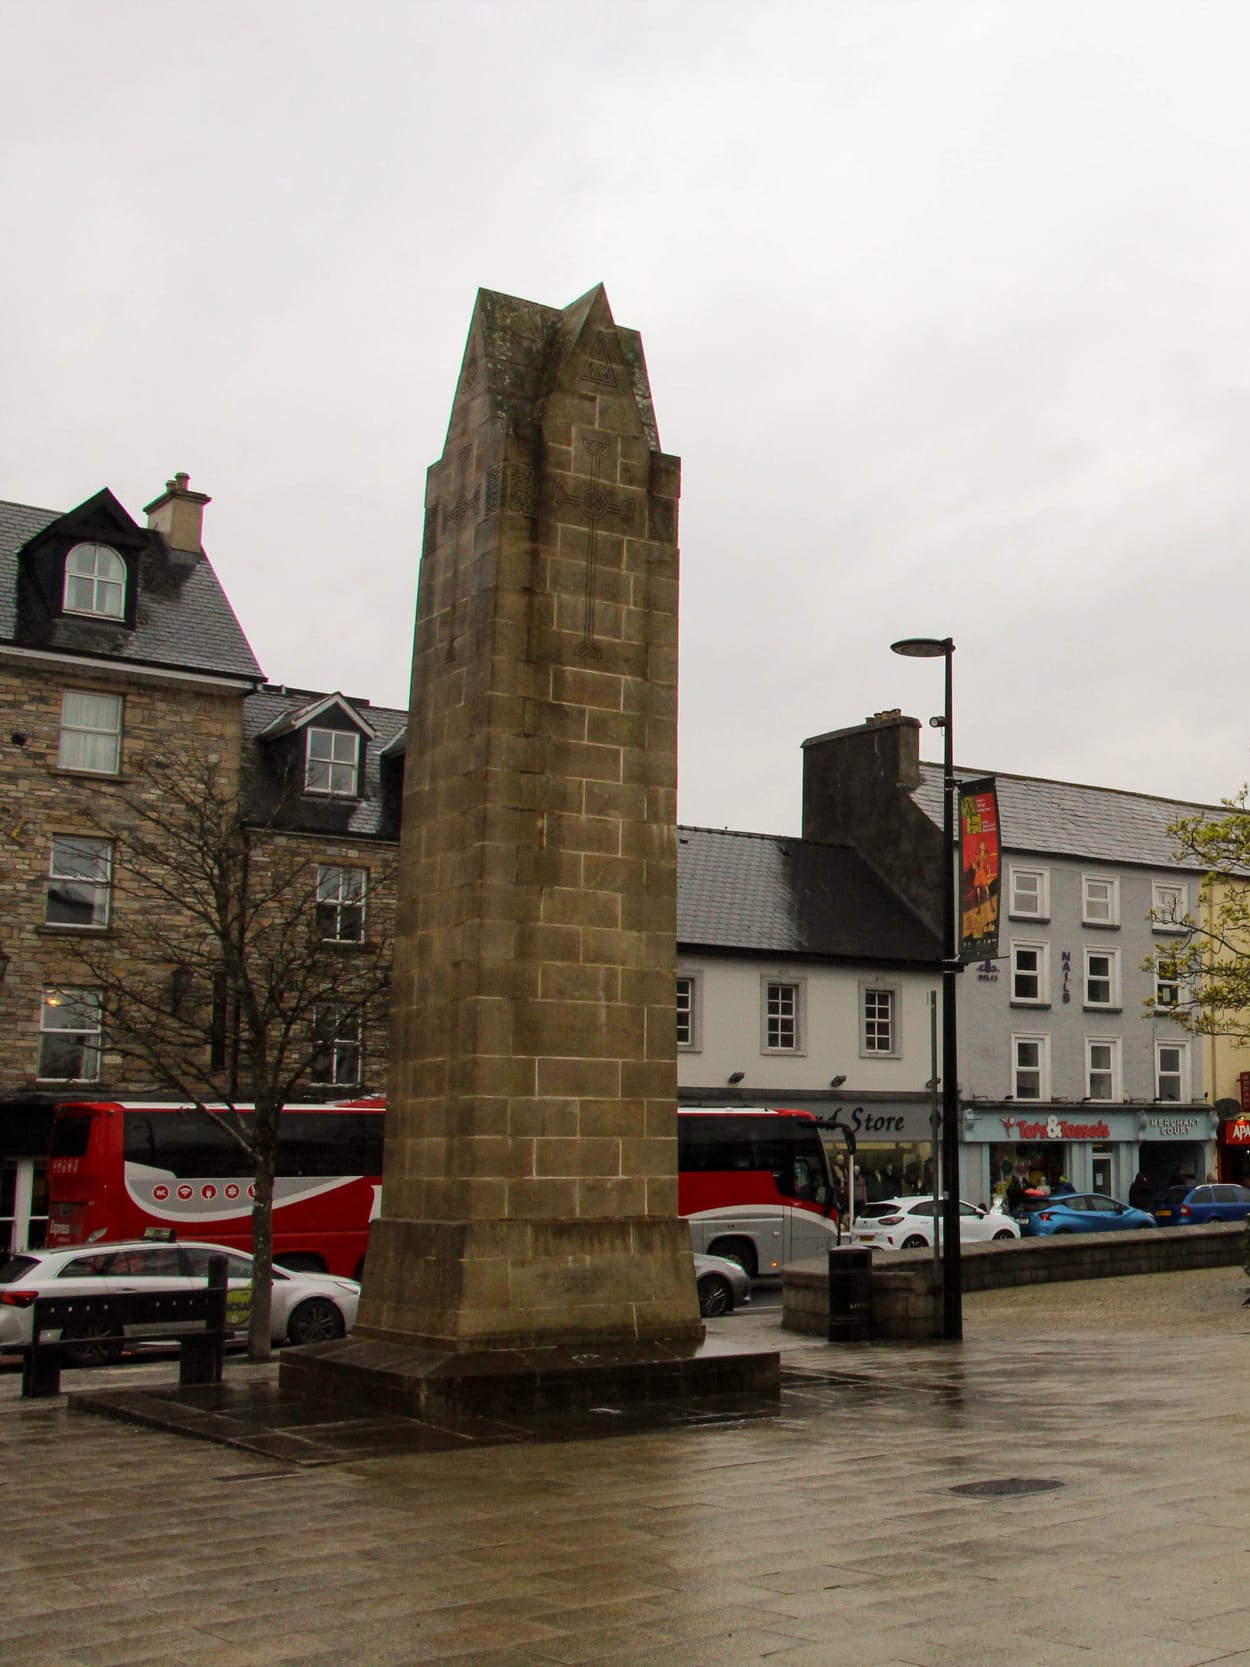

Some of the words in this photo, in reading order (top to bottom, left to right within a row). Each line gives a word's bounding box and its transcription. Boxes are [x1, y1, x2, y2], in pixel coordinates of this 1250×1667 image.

[1062, 951, 1071, 1003] NAILS
[851, 1107, 904, 1132] Store
[1046, 1115, 1063, 1139] &
[1150, 1118, 1200, 1128] MERCHANT
[1160, 1126, 1191, 1136] COURT
